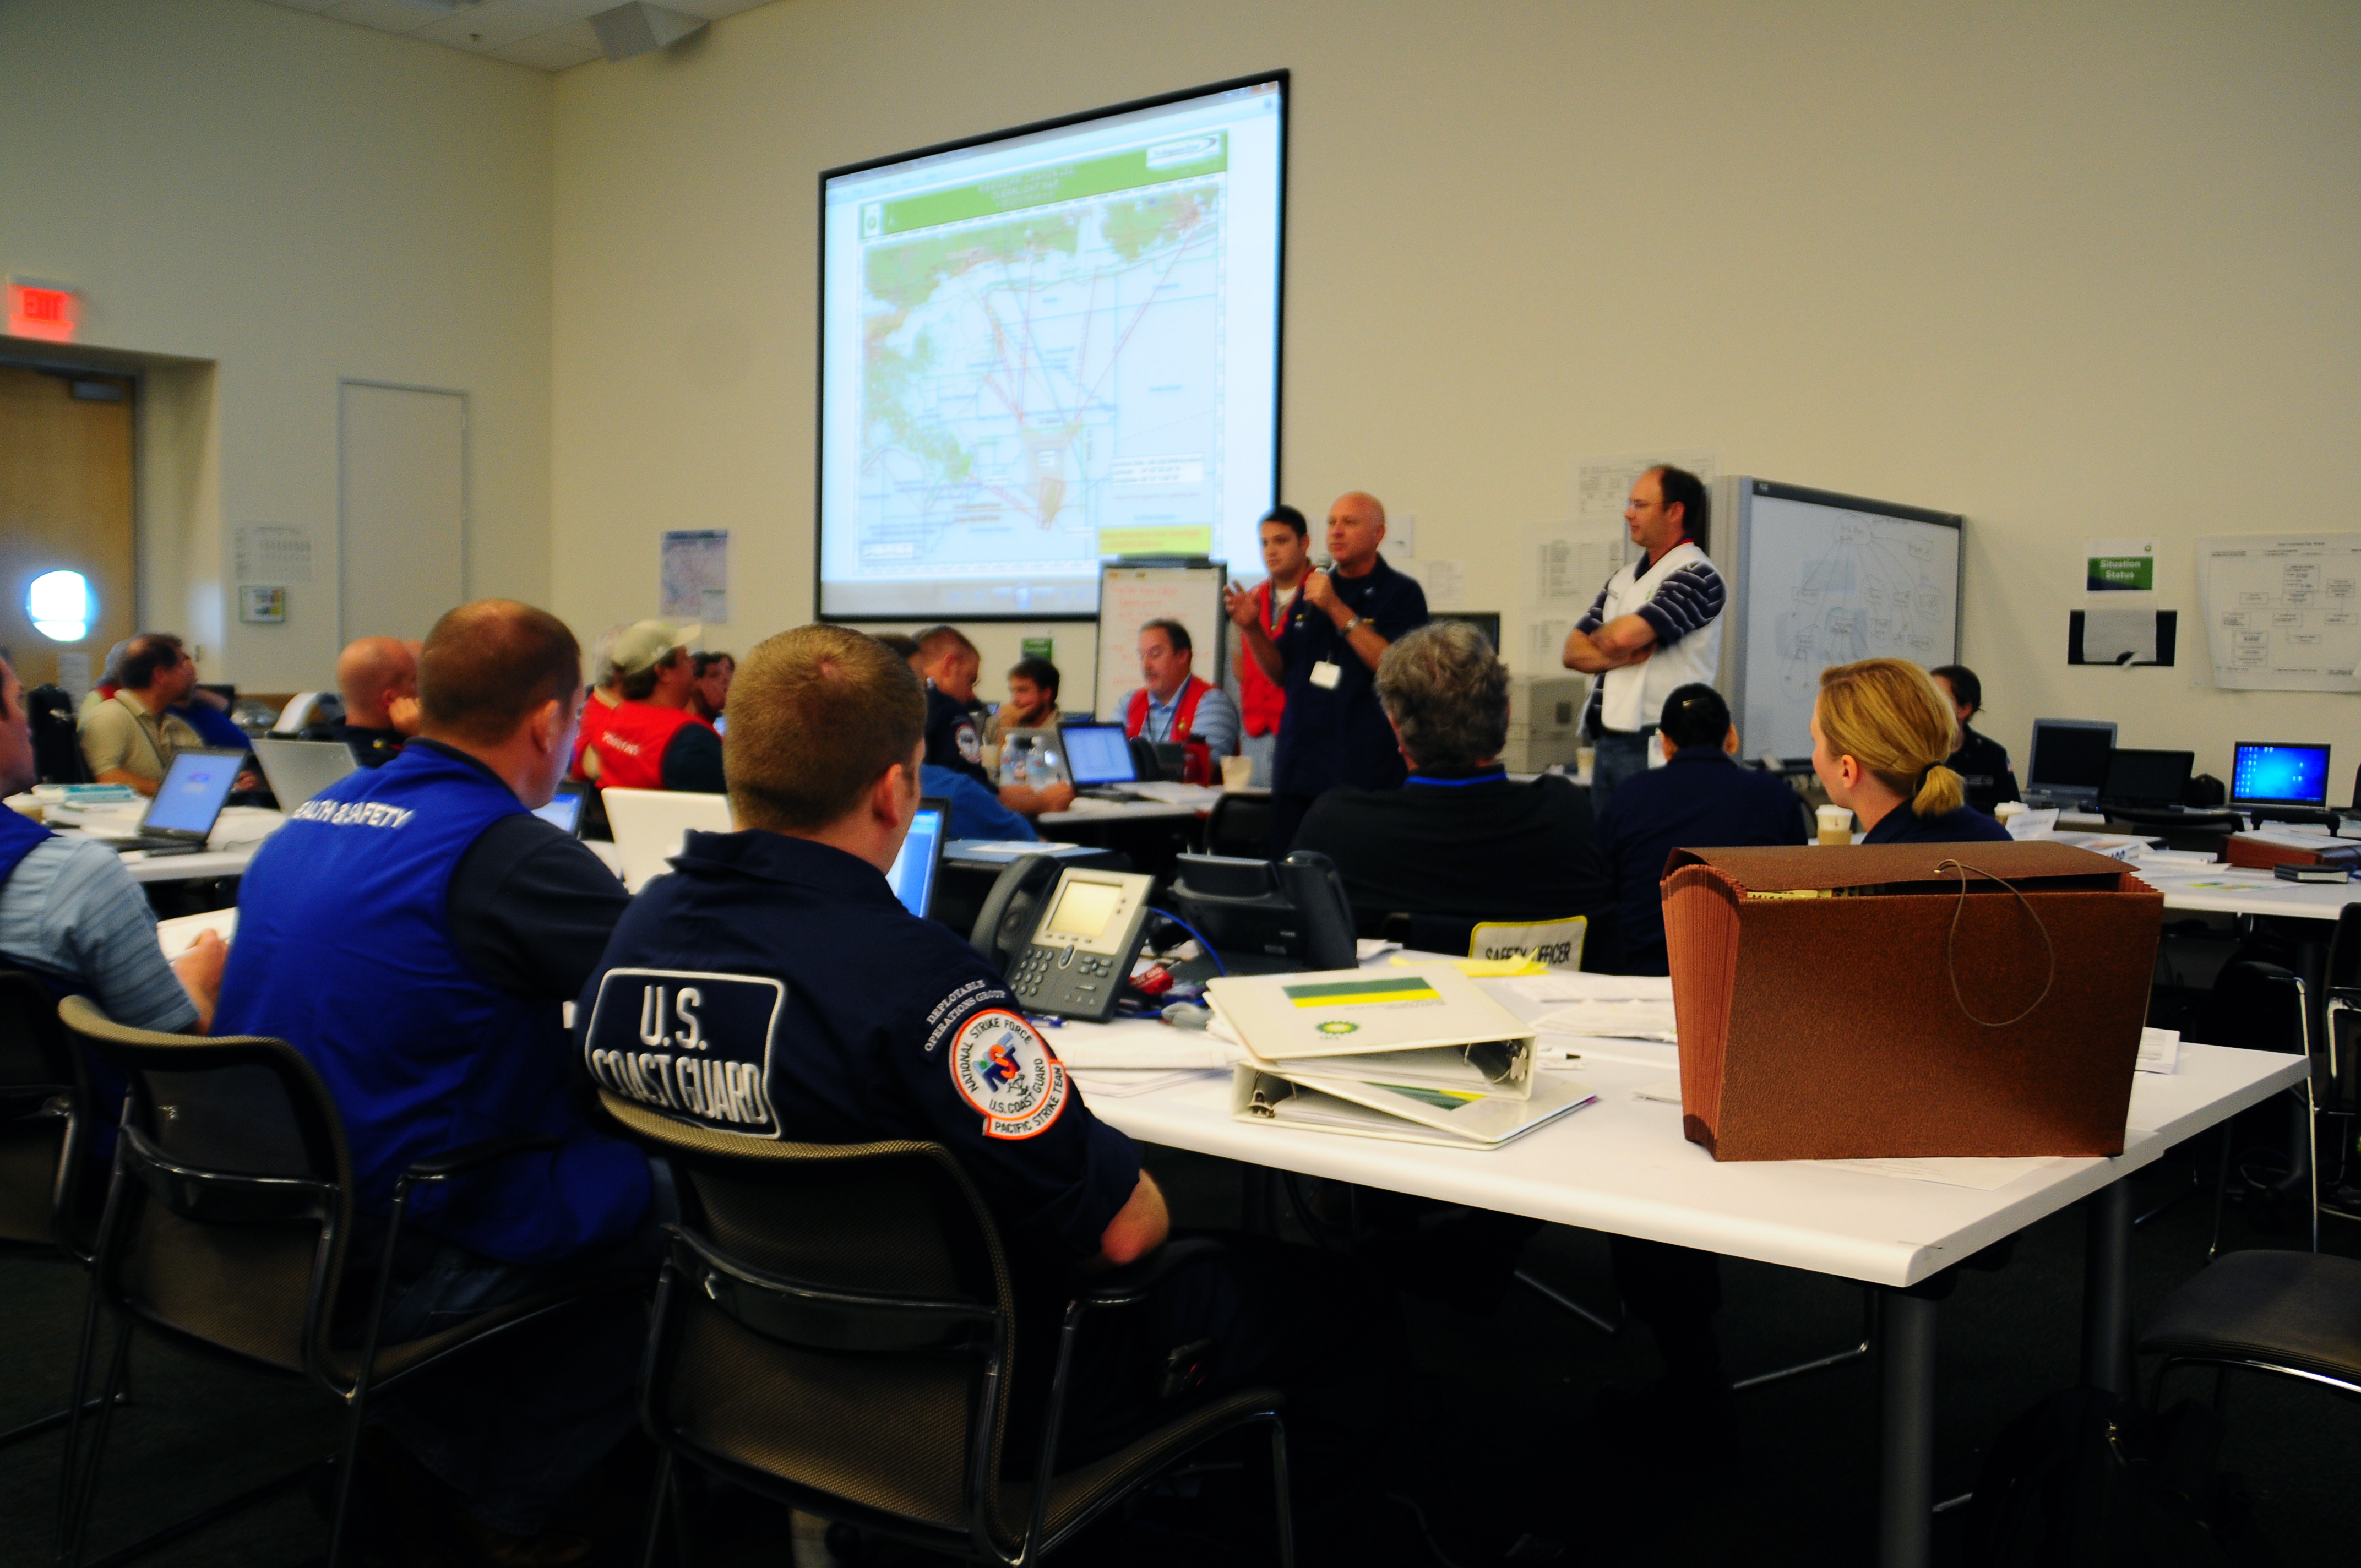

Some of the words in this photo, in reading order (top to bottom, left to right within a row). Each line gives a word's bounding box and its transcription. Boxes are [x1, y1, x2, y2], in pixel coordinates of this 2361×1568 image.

[24, 291, 64, 320] EXIT
[2100, 559, 2141, 568] Situation
[2105, 570, 2135, 579] Status
[331, 802, 353, 825] &
[344, 801, 415, 828] SAFETY
[640, 985, 708, 1050] U.S.
[924, 997, 977, 1052] OPERATIONS
[975, 990, 1006, 1002] GROUP
[926, 979, 986, 1025] DEPLOYABLE
[969, 1017, 1001, 1039] STRIKE
[1004, 1020, 1033, 1044] FORCE
[592, 1049, 681, 1110] COAST
[676, 1057, 768, 1124] GUARD
[960, 1042, 979, 1093] NATIONAL
[989, 1099, 1006, 1113] U.S.
[1007, 1092, 1037, 1113] COAST
[1032, 1058, 1045, 1093] GUARD
[995, 1120, 1033, 1134] PACIFIC
[1032, 1096, 1060, 1126] STRIKE
[1053, 1067, 1063, 1094] TEAM
